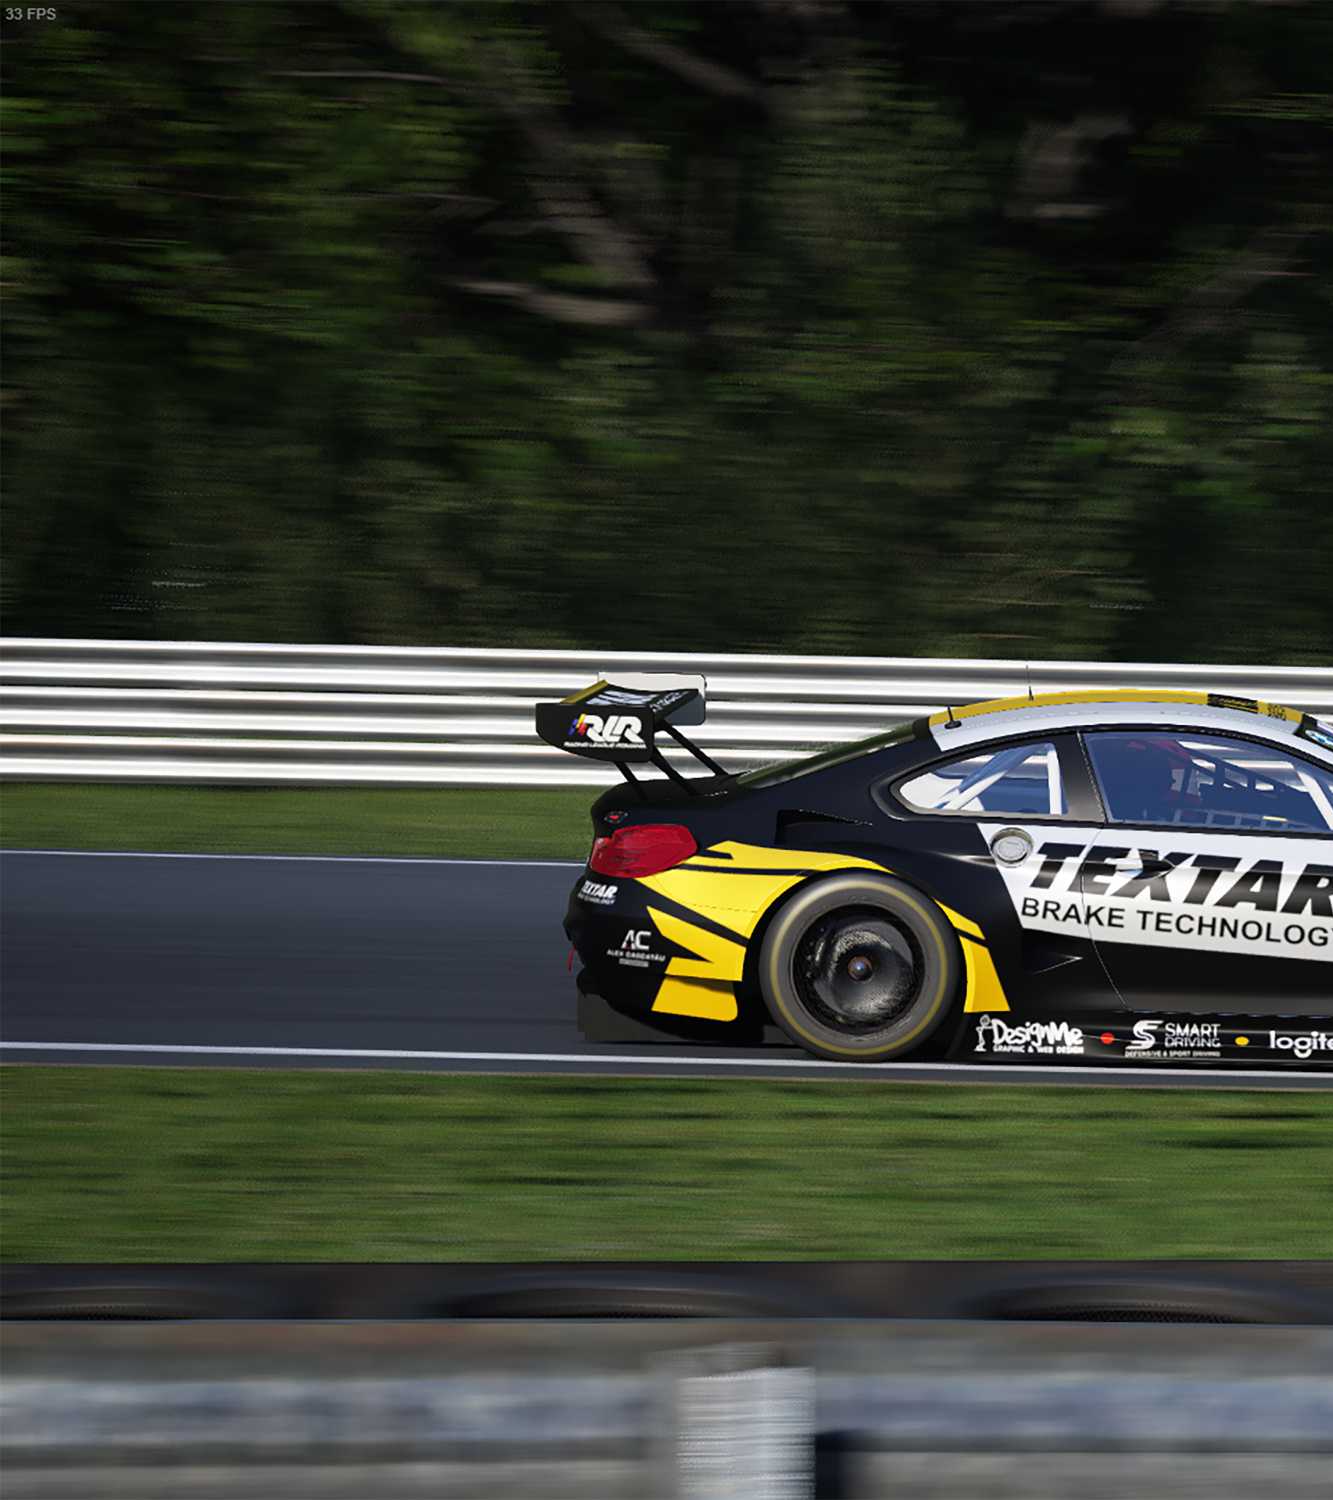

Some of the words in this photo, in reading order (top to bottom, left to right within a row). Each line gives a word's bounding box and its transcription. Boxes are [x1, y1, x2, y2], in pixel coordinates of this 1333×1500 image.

[581, 714, 645, 743] RLR
[1021, 897, 1125, 928] BRAKE
[621, 929, 652, 950] AC
[1165, 1022, 1221, 1038] SMART
[1164, 1036, 1221, 1048] DRIVING
